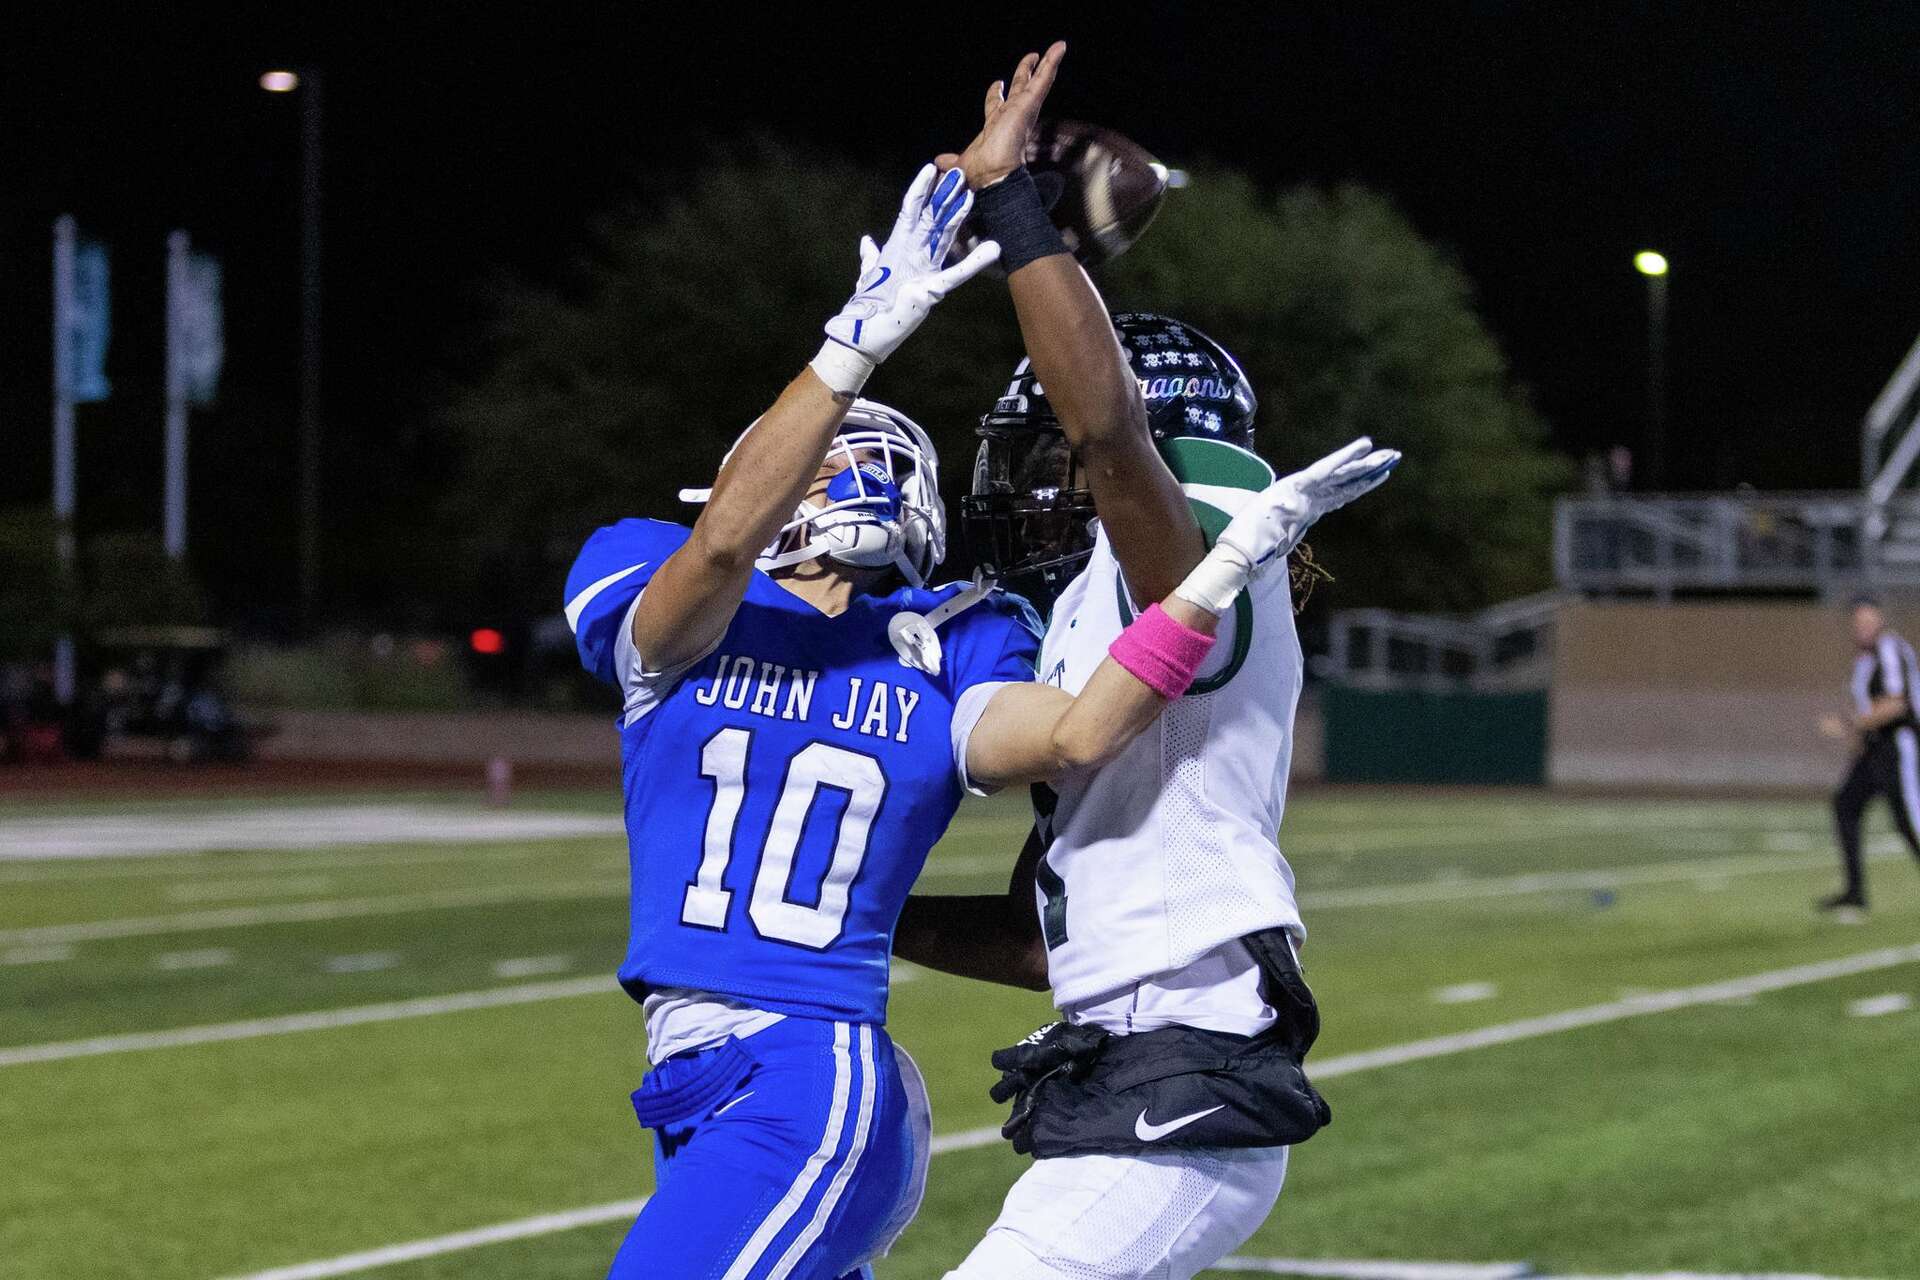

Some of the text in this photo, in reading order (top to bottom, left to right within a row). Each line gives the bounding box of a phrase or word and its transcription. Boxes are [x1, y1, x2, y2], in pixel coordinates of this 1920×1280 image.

[1136, 377, 1231, 400] ragons
[696, 655, 920, 743] JOHN JAY
[680, 728, 889, 953] 10
